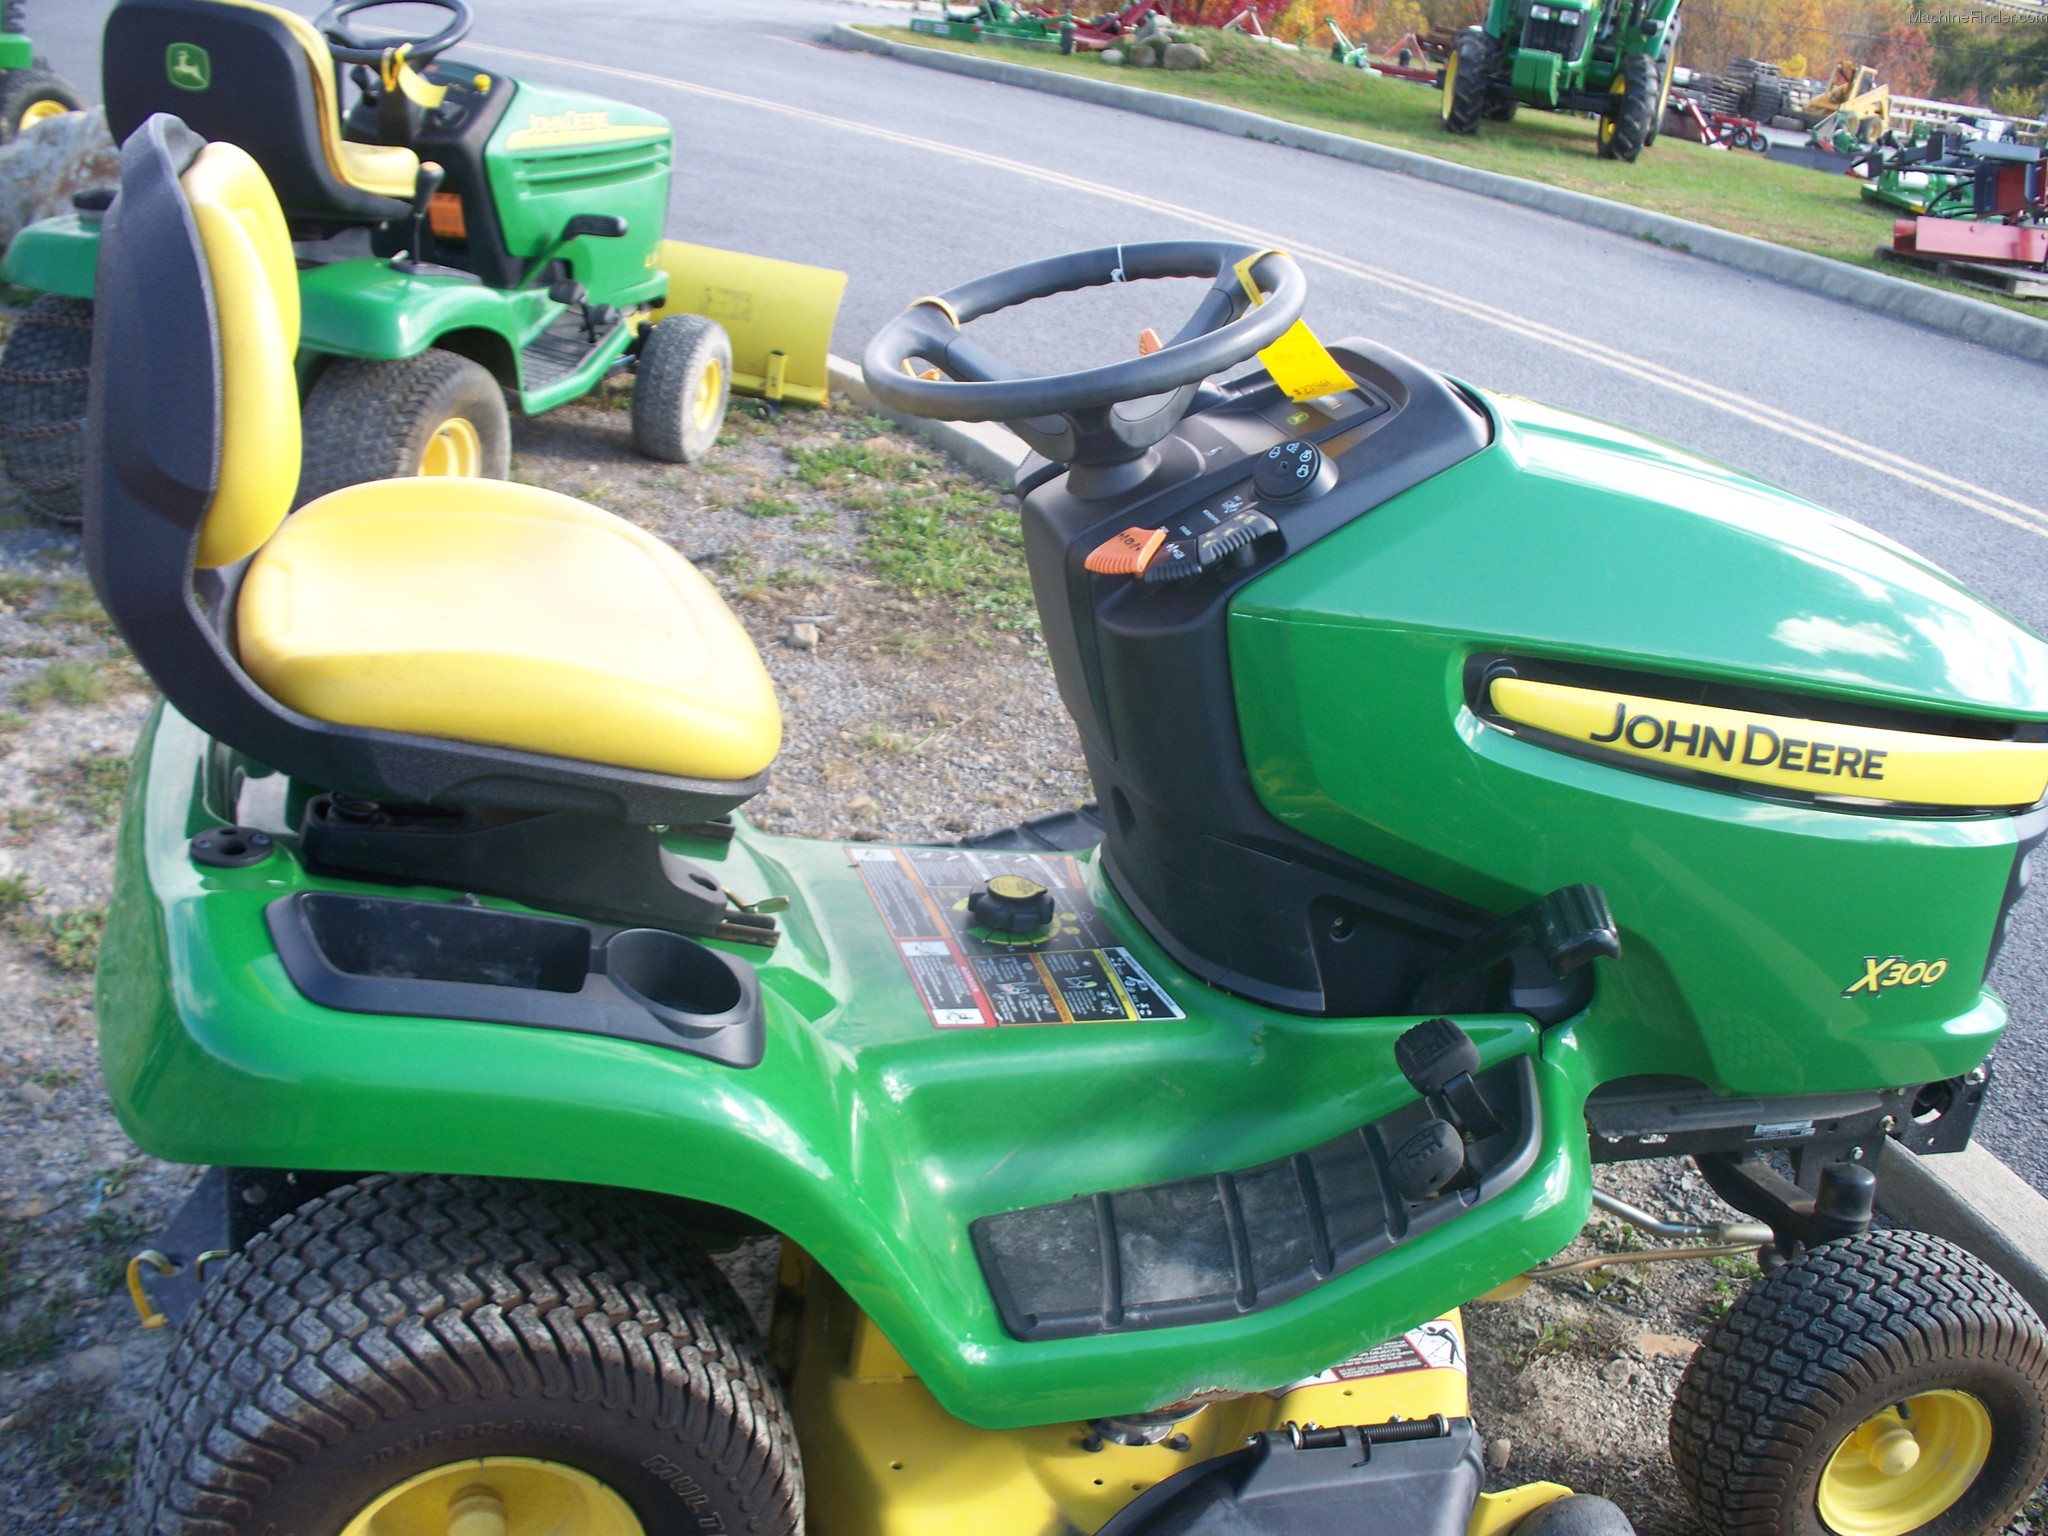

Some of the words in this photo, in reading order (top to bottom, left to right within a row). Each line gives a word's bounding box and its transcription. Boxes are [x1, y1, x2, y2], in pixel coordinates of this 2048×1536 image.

[1590, 702, 1737, 762] JOHN
[1741, 723, 1888, 780] DEERE
[1842, 957, 1949, 994] X300
[640, 1453, 729, 1536] MULT
